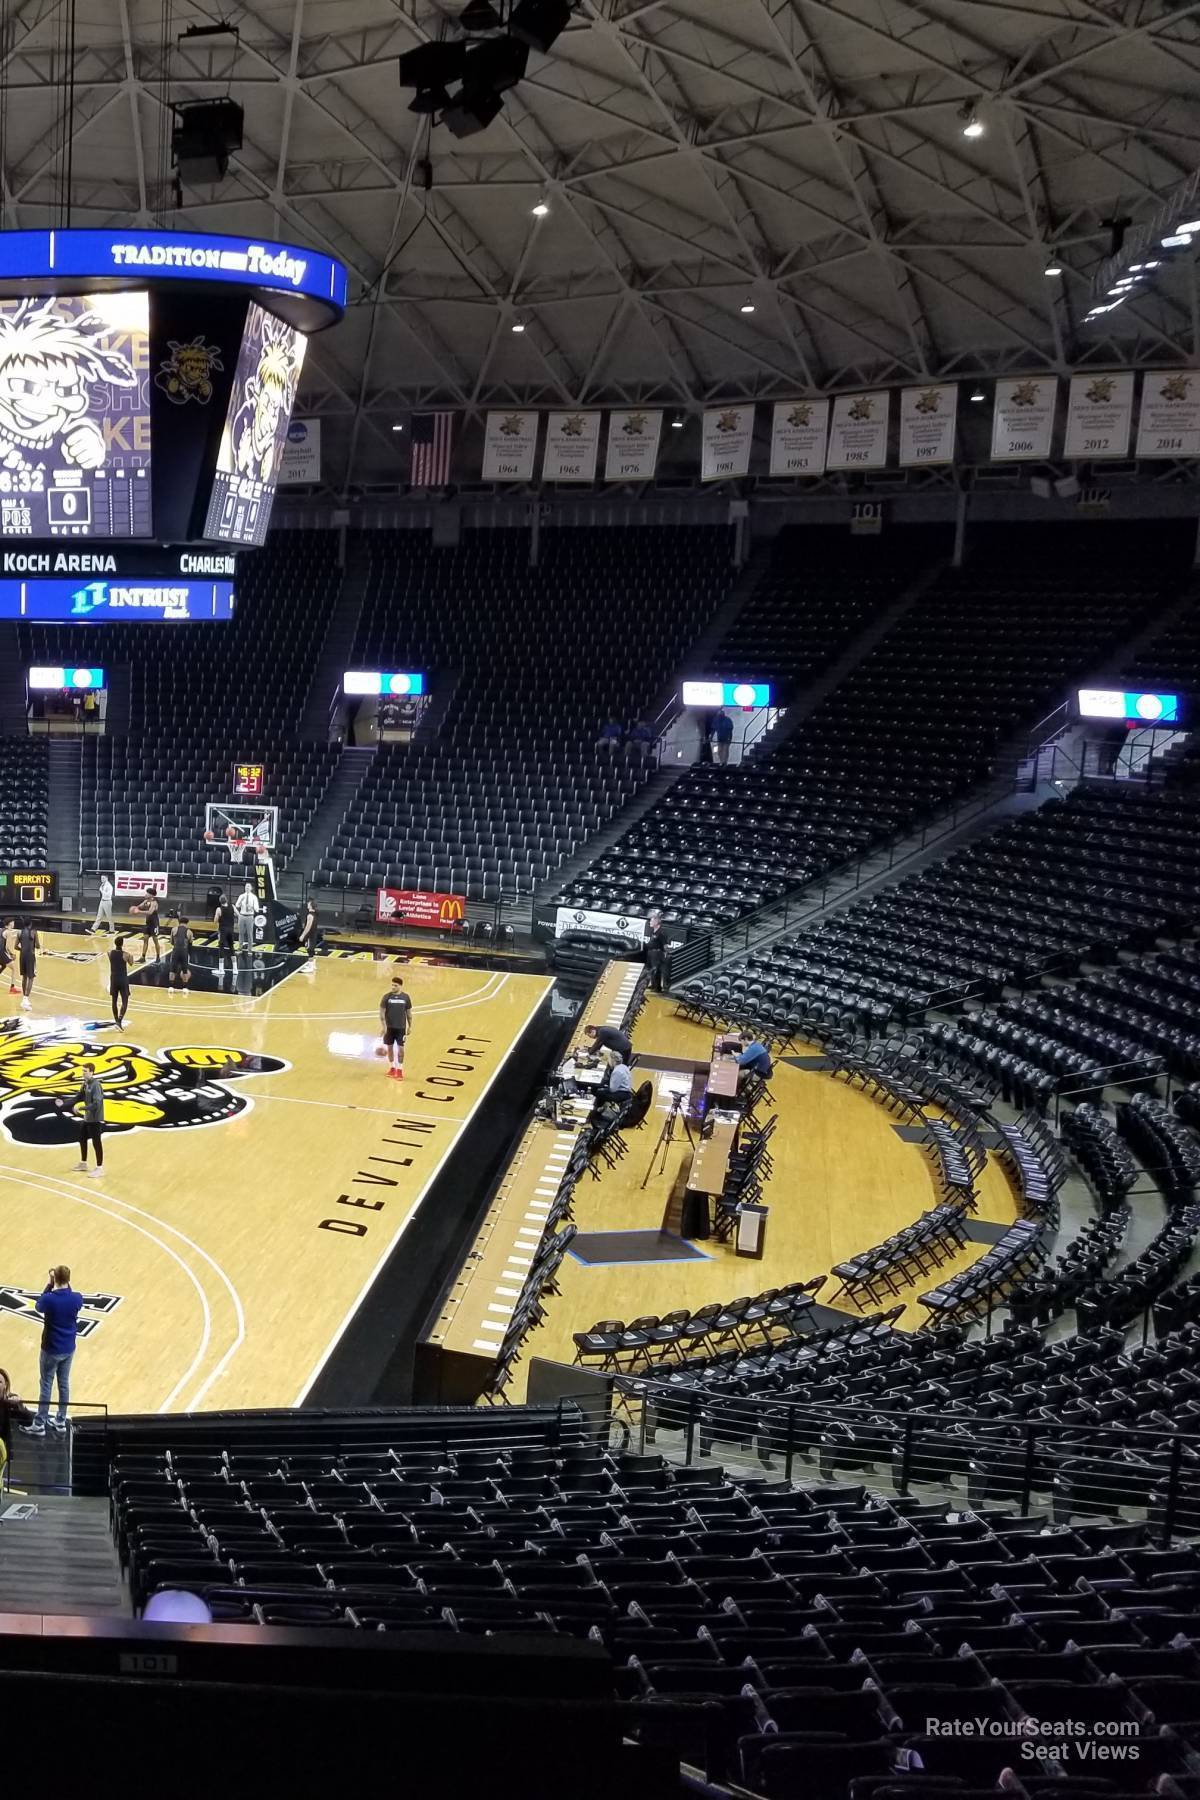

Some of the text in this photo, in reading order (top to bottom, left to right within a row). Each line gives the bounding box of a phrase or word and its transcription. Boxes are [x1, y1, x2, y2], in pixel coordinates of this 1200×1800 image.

[111, 244, 307, 286] TRADITION Today
[1008, 441, 1033, 452] 2006
[1084, 439, 1109, 450] 2012
[1156, 439, 1182, 449] 2014
[846, 452, 869, 461] 1985
[916, 446, 937, 457] 1987
[497, 464, 518, 473] 1964
[559, 465, 580, 474] 1965
[620, 464, 640, 473] 1976
[716, 463, 733, 472] 1981
[787, 459, 809, 468] 1983
[1080, 487, 1111, 504] 102
[62, 493, 77, 515] 0
[853, 503, 882, 518] 101
[3, 509, 32, 526] POS
[4, 553, 50, 572] KOCH
[54, 553, 117, 572] ARENA
[180, 554, 224, 573] CHARLES
[109, 587, 190, 607] INTRUST
[240, 777, 257, 791] 23
[14, 874, 52, 884] BEARCATS
[116, 877, 165, 890] ESPN
[255, 865, 266, 899] WSU
[400, 899, 432, 907] Enterprises
[406, 912, 431, 920] Athletics
[318, 1034, 492, 1239] DEVLIN COURT
[129, 1655, 173, 1672] 101
